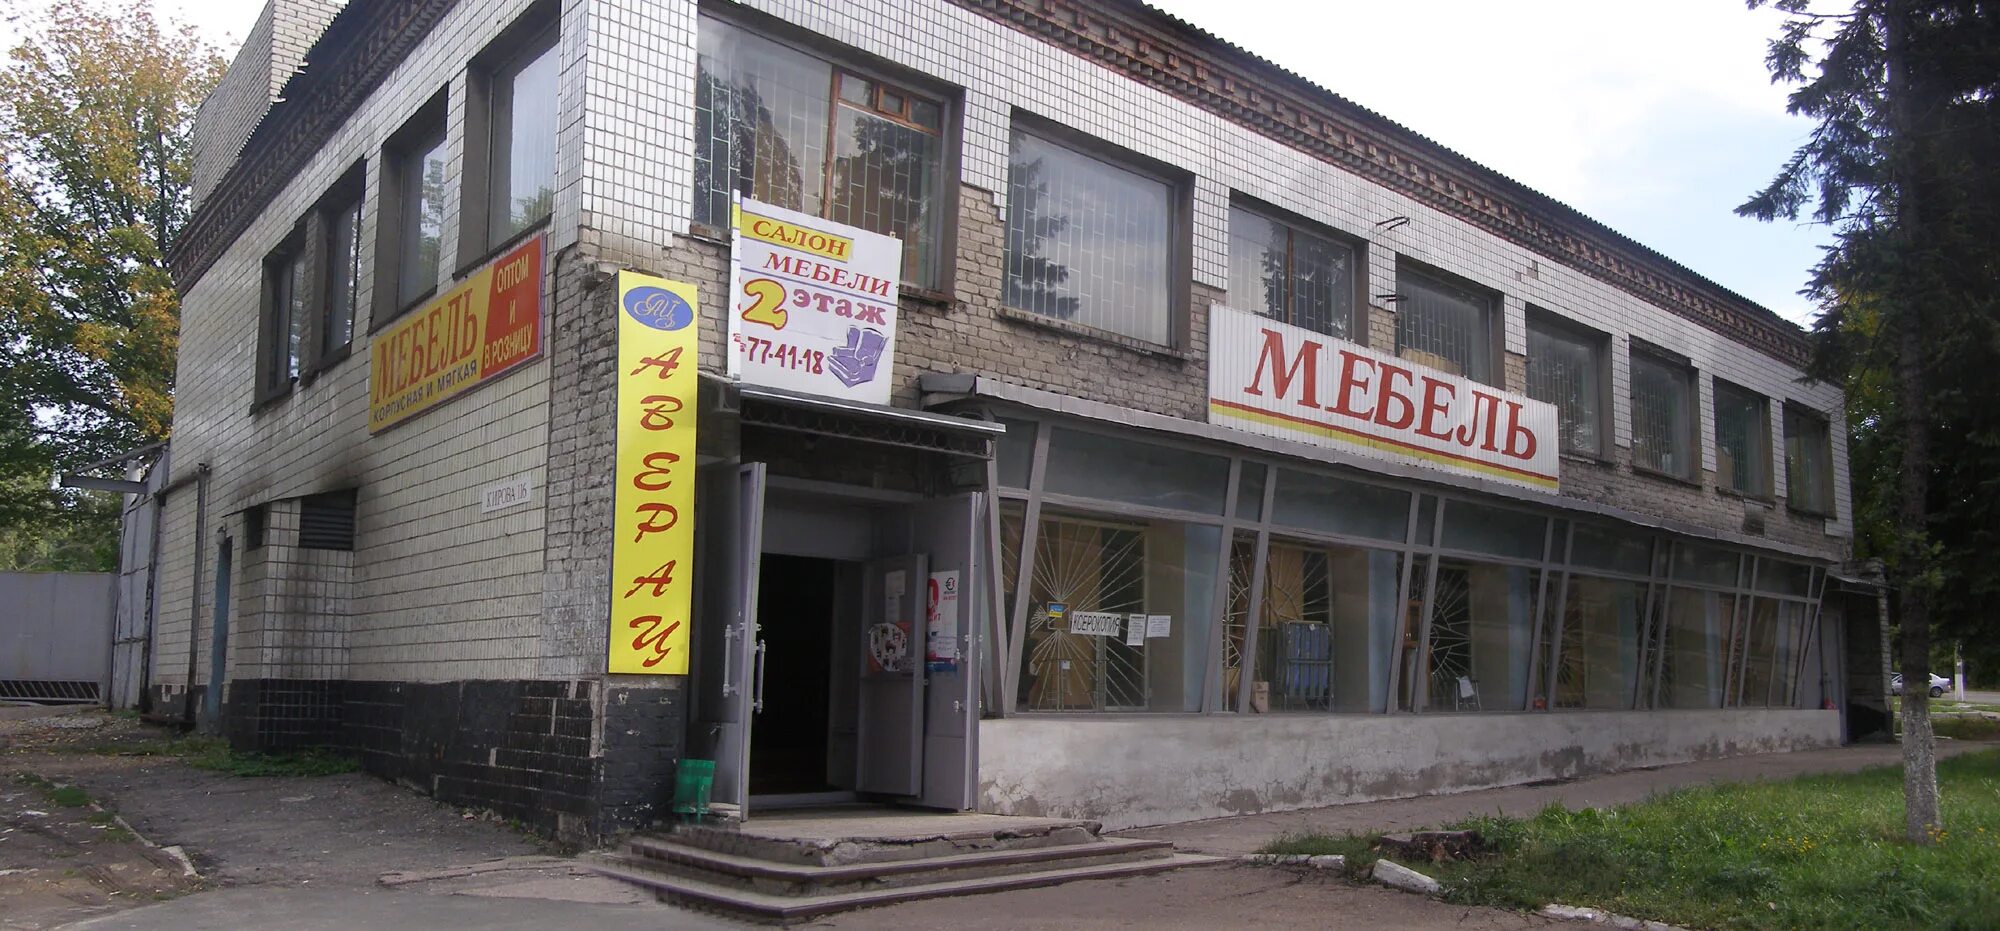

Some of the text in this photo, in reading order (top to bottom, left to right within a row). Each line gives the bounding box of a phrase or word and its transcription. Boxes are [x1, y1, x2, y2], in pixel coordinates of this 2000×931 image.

[753, 220, 847, 257] САЛОН
[497, 254, 529, 293] ОПТОМ
[762, 252, 891, 297] МЕБЕЛИ
[509, 299, 516, 326] И
[741, 278, 886, 330] 2 этаж
[374, 288, 478, 404] МЕБЕЛЬ
[484, 323, 532, 369] В РОЗНИЦУ
[373, 359, 477, 424] КОРПУСНАЯ И МЯГКАЯ
[1244, 328, 1537, 460] МЕБЕЛЬ
[1072, 613, 1120, 634] КСЕРОКОПИЯ
